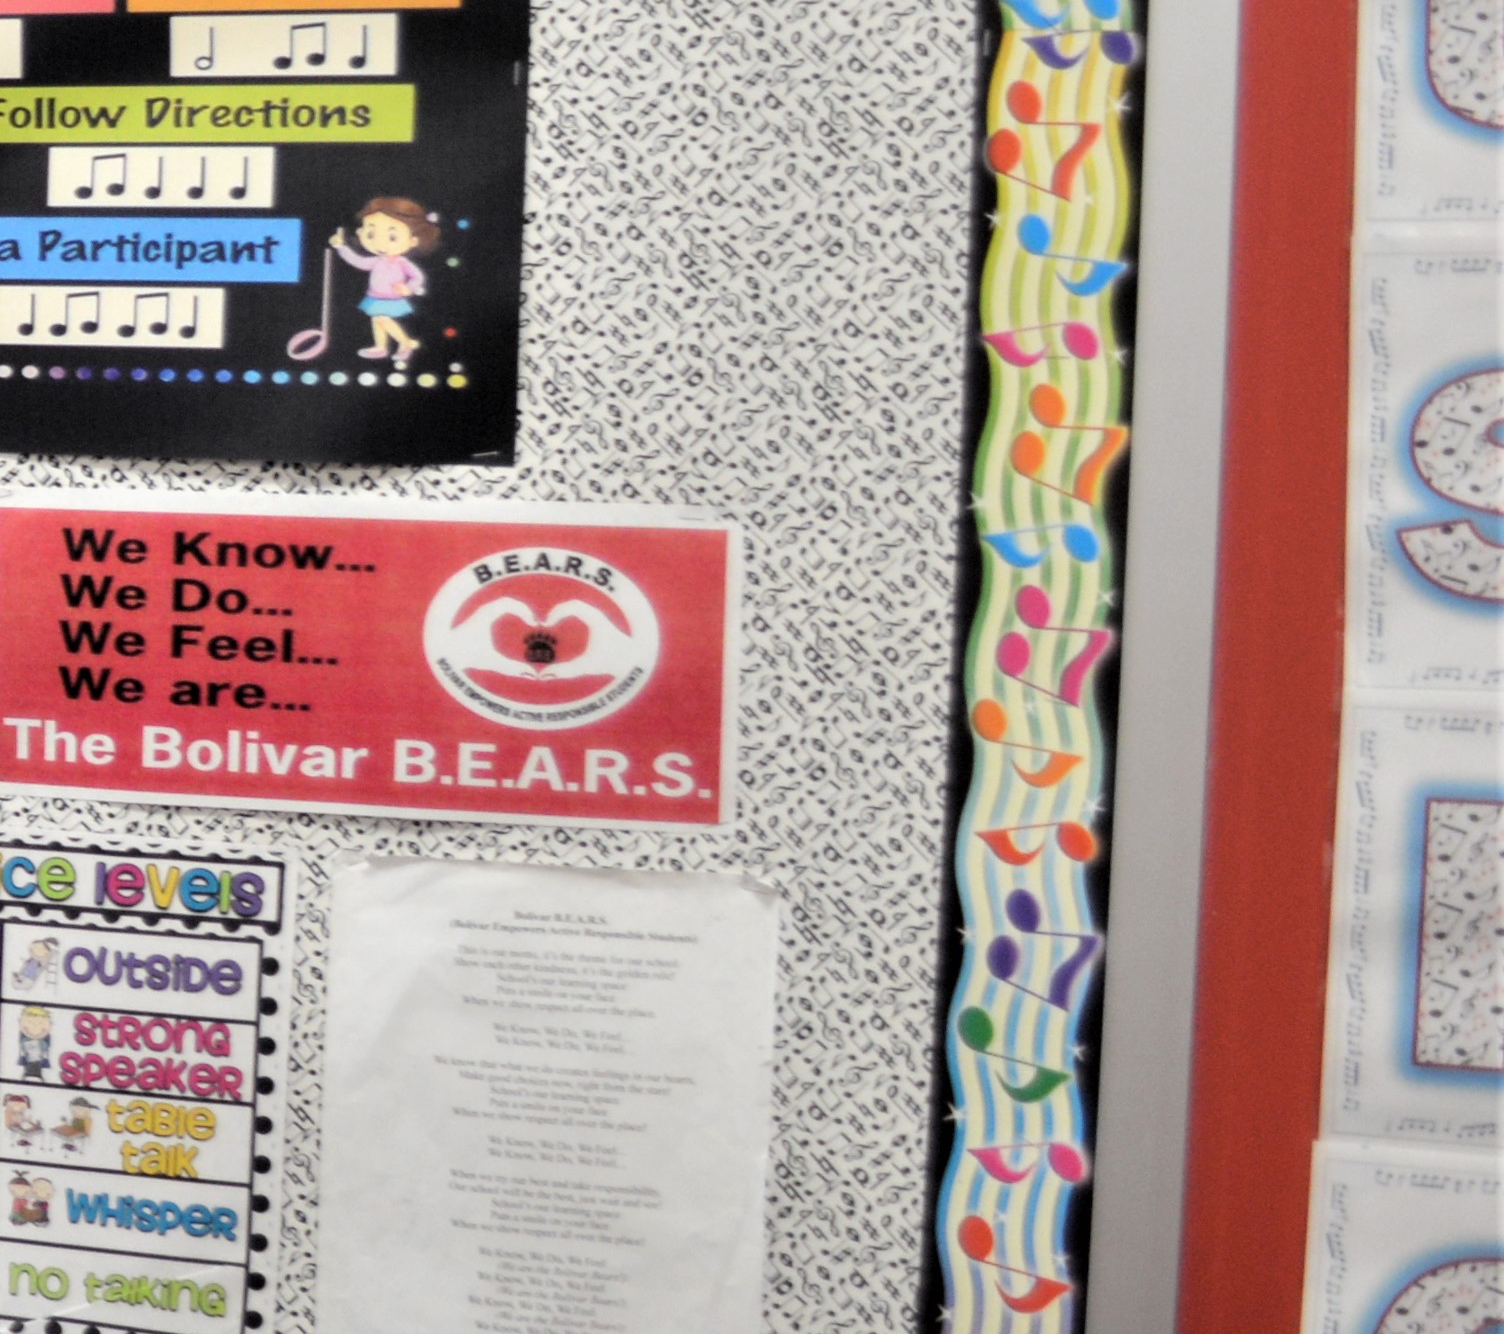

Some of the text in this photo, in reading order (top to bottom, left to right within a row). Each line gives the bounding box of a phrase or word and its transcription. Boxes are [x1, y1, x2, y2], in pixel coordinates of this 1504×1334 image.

[144, 95, 372, 129] Directions
[37, 227, 281, 268] Participant
[62, 527, 376, 573] We Know...
[473, 552, 616, 592] B.E.A.R.S.
[61, 573, 294, 616] We Do...
[59, 619, 339, 666] We Feel...
[58, 665, 312, 712] We are...
[2, 716, 713, 800] The Bolivar B.E.A.R.S.
